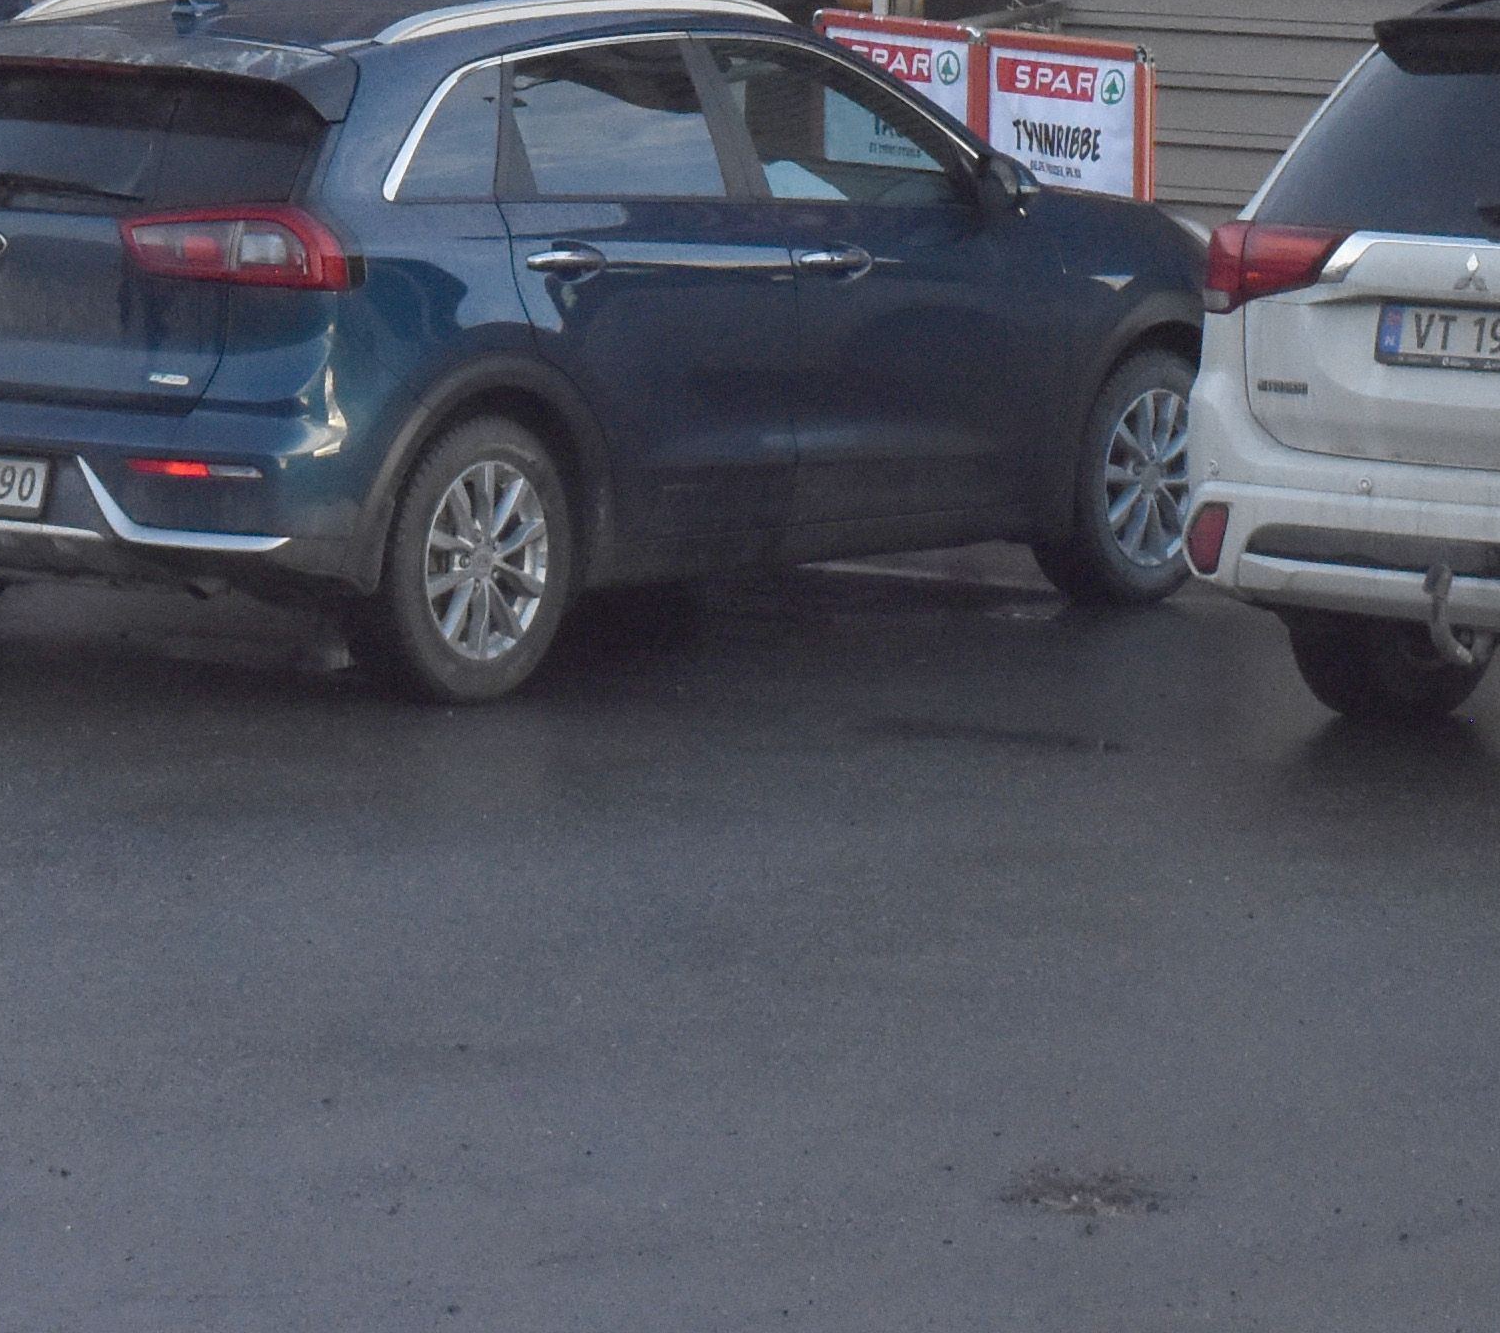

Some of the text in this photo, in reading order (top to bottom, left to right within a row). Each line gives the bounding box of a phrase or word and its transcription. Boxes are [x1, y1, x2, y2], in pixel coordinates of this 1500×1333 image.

[1014, 64, 1094, 96] SPAR
[1012, 119, 1101, 162] TYNNRIBBE
[1414, 312, 1457, 350] VT
